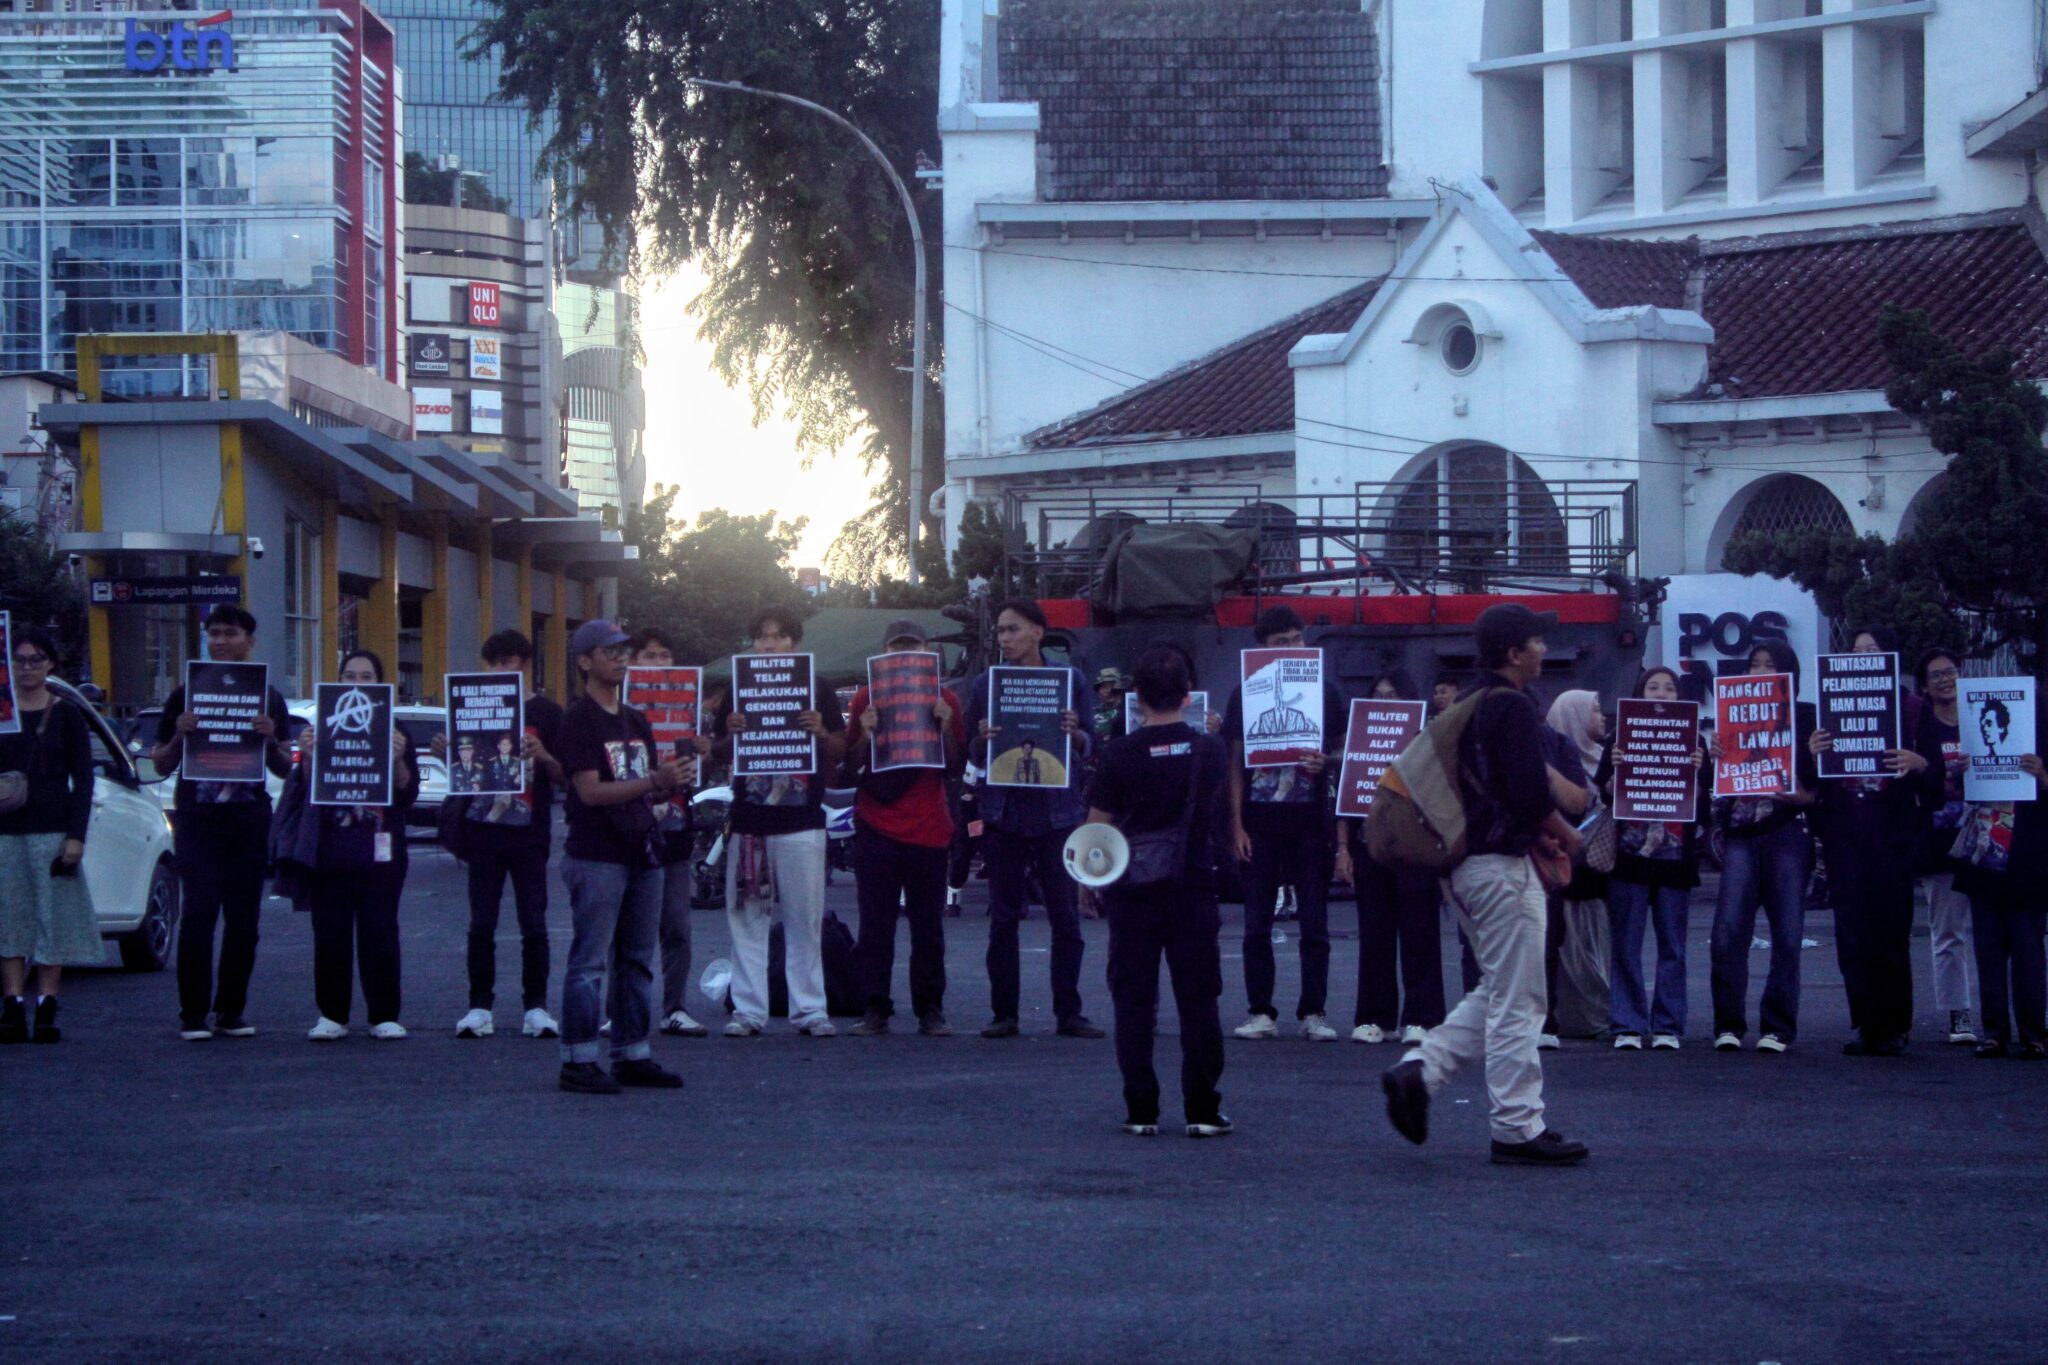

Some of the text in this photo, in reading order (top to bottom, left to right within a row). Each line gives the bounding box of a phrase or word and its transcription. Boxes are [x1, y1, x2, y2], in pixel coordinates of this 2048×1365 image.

[124, 17, 234, 70] btn
[473, 287, 495, 303] UNI
[473, 305, 497, 321] QLO
[134, 586, 188, 599] Lapangan
[191, 585, 238, 595] Merdeka
[1679, 611, 1790, 657] POS
[750, 658, 795, 669] MILITER
[1282, 660, 1319, 668] SENJATA API
[1828, 656, 1886, 672] TUNTASKAN
[754, 673, 791, 682] TELAH
[1822, 676, 1893, 692] PELANGGARAN
[460, 685, 479, 696] KALI
[480, 684, 517, 696] PRESIDEN
[739, 687, 808, 698] MELAKUKAN
[1719, 681, 1774, 699] BANGKIT
[193, 694, 260, 704] KEBENARAN DARI
[1968, 691, 2022, 701] WIJI THUKUL
[745, 702, 802, 712] GENOSIDA
[1830, 697, 1887, 712] HAM MASA
[193, 707, 259, 717] RAKYAT ADALAH
[455, 706, 515, 719] PENJAHAT HAM
[1367, 711, 1410, 721] MILITER
[1728, 702, 1779, 723] REBUT
[196, 720, 255, 730] ANCAMAN BAG
[455, 719, 480, 731] TIDAK
[762, 716, 785, 726] DAN
[1627, 717, 1690, 728] PEMERINTAH
[1840, 717, 1878, 732] LALU DI
[742, 730, 807, 741] KEJAHATAN
[1366, 725, 1404, 735] BUKAN
[1631, 730, 1682, 739] BISA APA?
[208, 733, 241, 743] NEGARA
[334, 739, 371, 750] SENJATA
[1369, 740, 1397, 749] ALAT
[1627, 742, 1687, 752] HAK WARGA
[1832, 737, 1886, 752] SUMATERA
[738, 745, 811, 756] KEMANUSIAN
[1347, 752, 1401, 762] PERUSAHA
[1662, 755, 1692, 764] TIDAK
[1974, 756, 1996, 765] TIDAK
[747, 759, 802, 770] 1965/1966
[1719, 757, 1783, 778] Jangan
[1844, 758, 1876, 772] UTARA
[1632, 767, 1680, 776] DIPENUHI
[1356, 780, 1378, 789] POL
[1625, 778, 1686, 788] MELANGGAR
[1357, 794, 1373, 804] KO
[1627, 791, 1684, 801] HAM MAKIN
[1632, 804, 1677, 813] MENJADI
